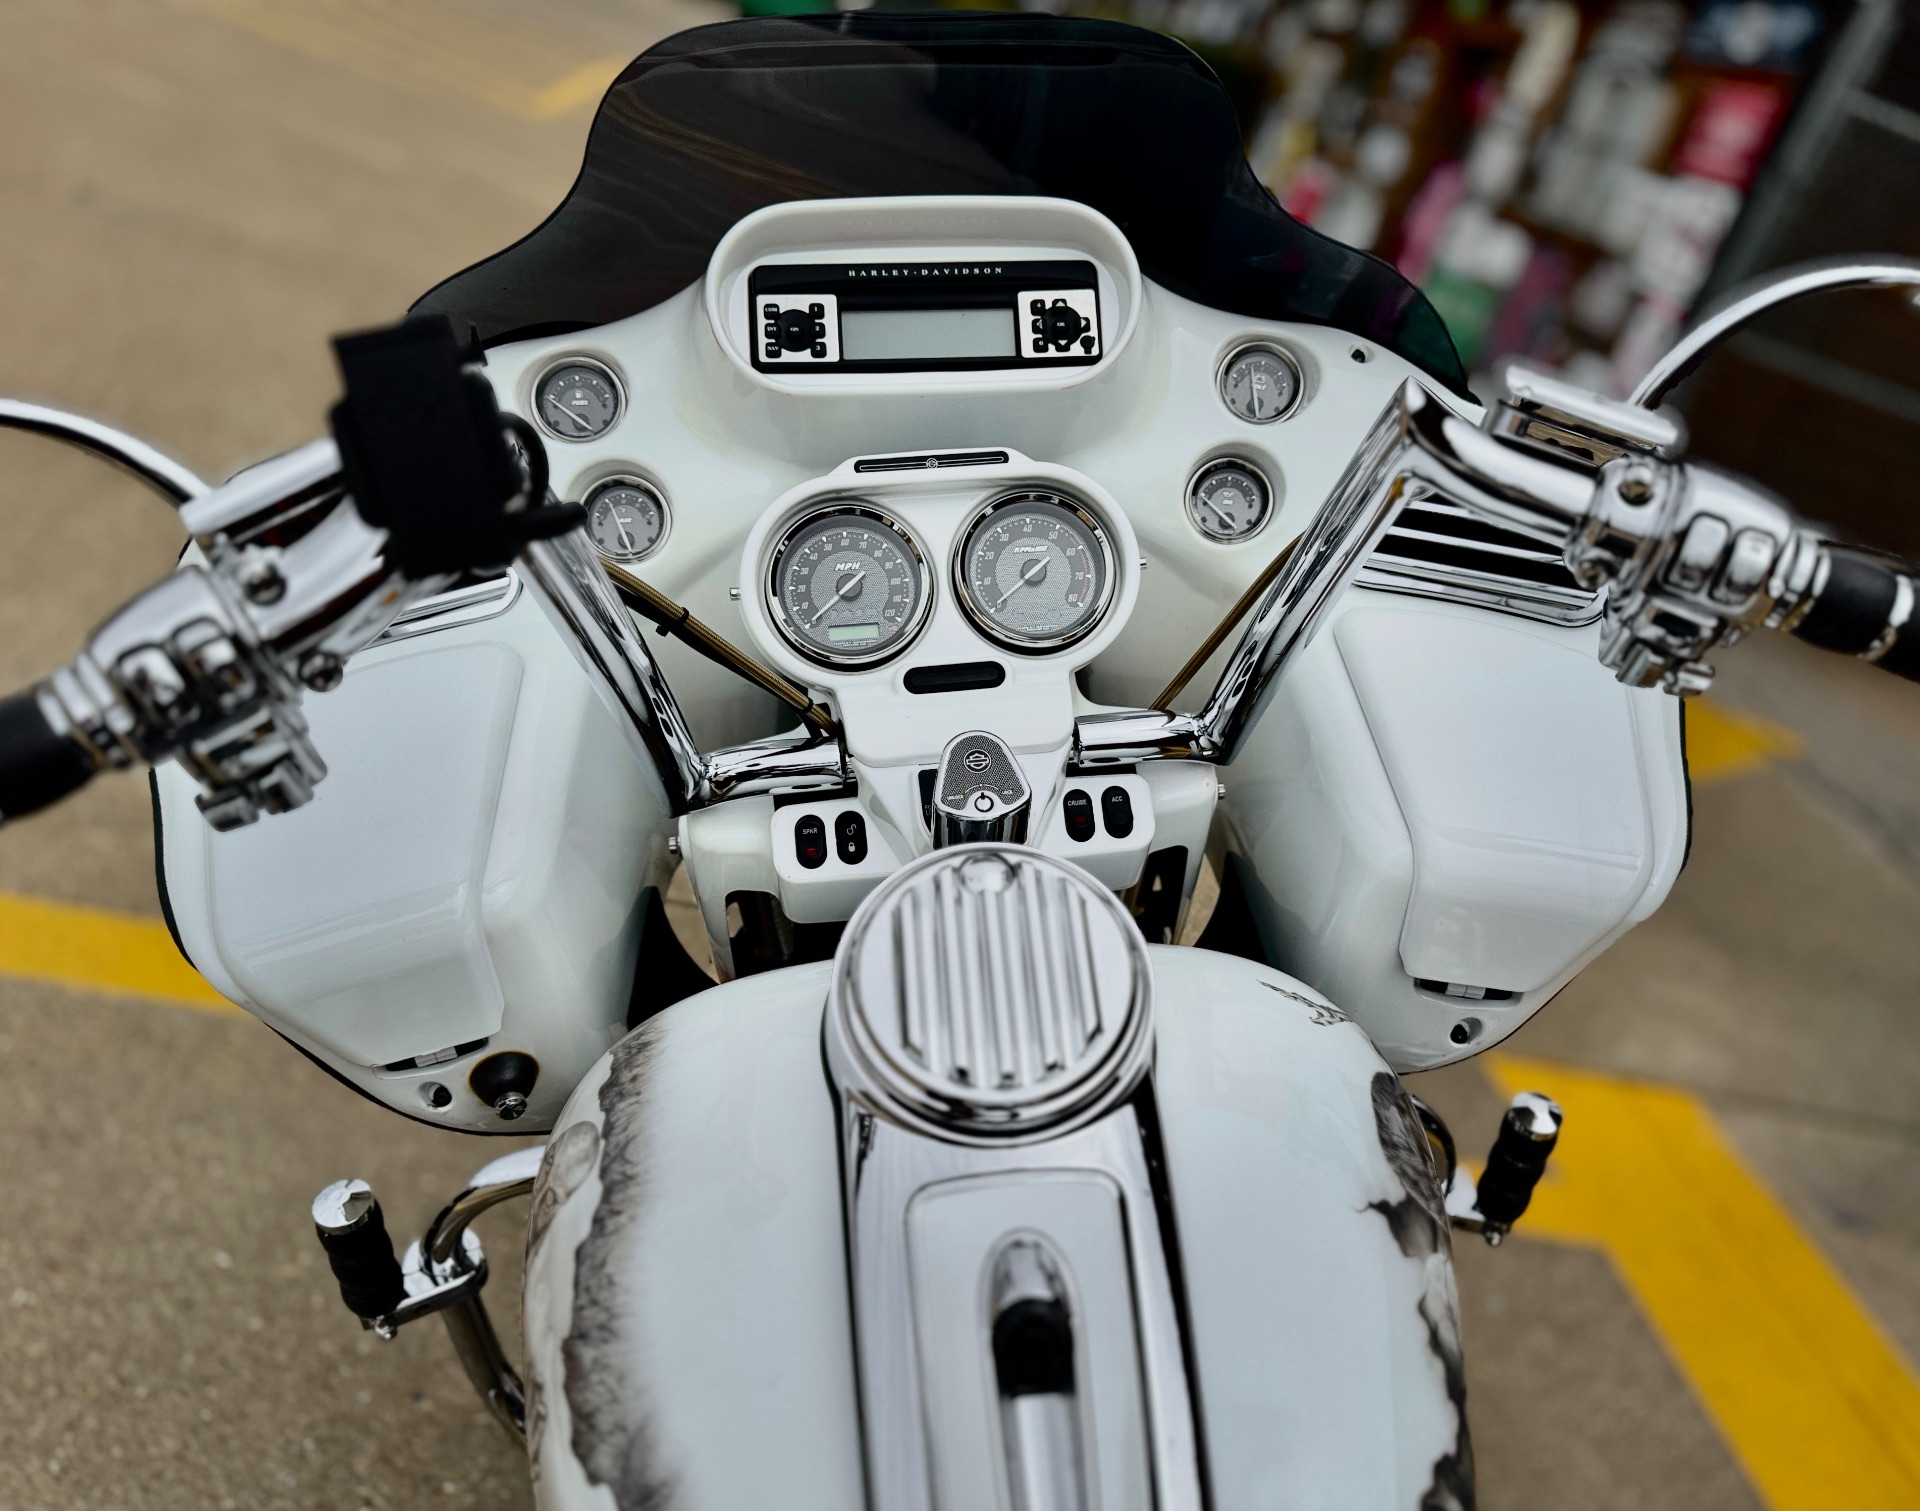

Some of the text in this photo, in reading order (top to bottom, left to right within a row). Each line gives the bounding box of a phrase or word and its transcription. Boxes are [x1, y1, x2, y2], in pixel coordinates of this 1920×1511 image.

[1023, 524, 1033, 532] 40
[999, 533, 1009, 542] 30
[1048, 531, 1058, 540] 50
[841, 538, 850, 546] 60
[859, 541, 868, 549] 70
[823, 543, 832, 551] 50
[873, 550, 883, 558] 80
[985, 551, 994, 560] 20
[1066, 548, 1076, 556] 60
[835, 562, 860, 571] MPH
[800, 567, 809, 575] 30
[1074, 572, 1084, 580] 70
[983, 577, 992, 585] 10
[1068, 593, 1078, 602] 80
[884, 609, 896, 617] 120
